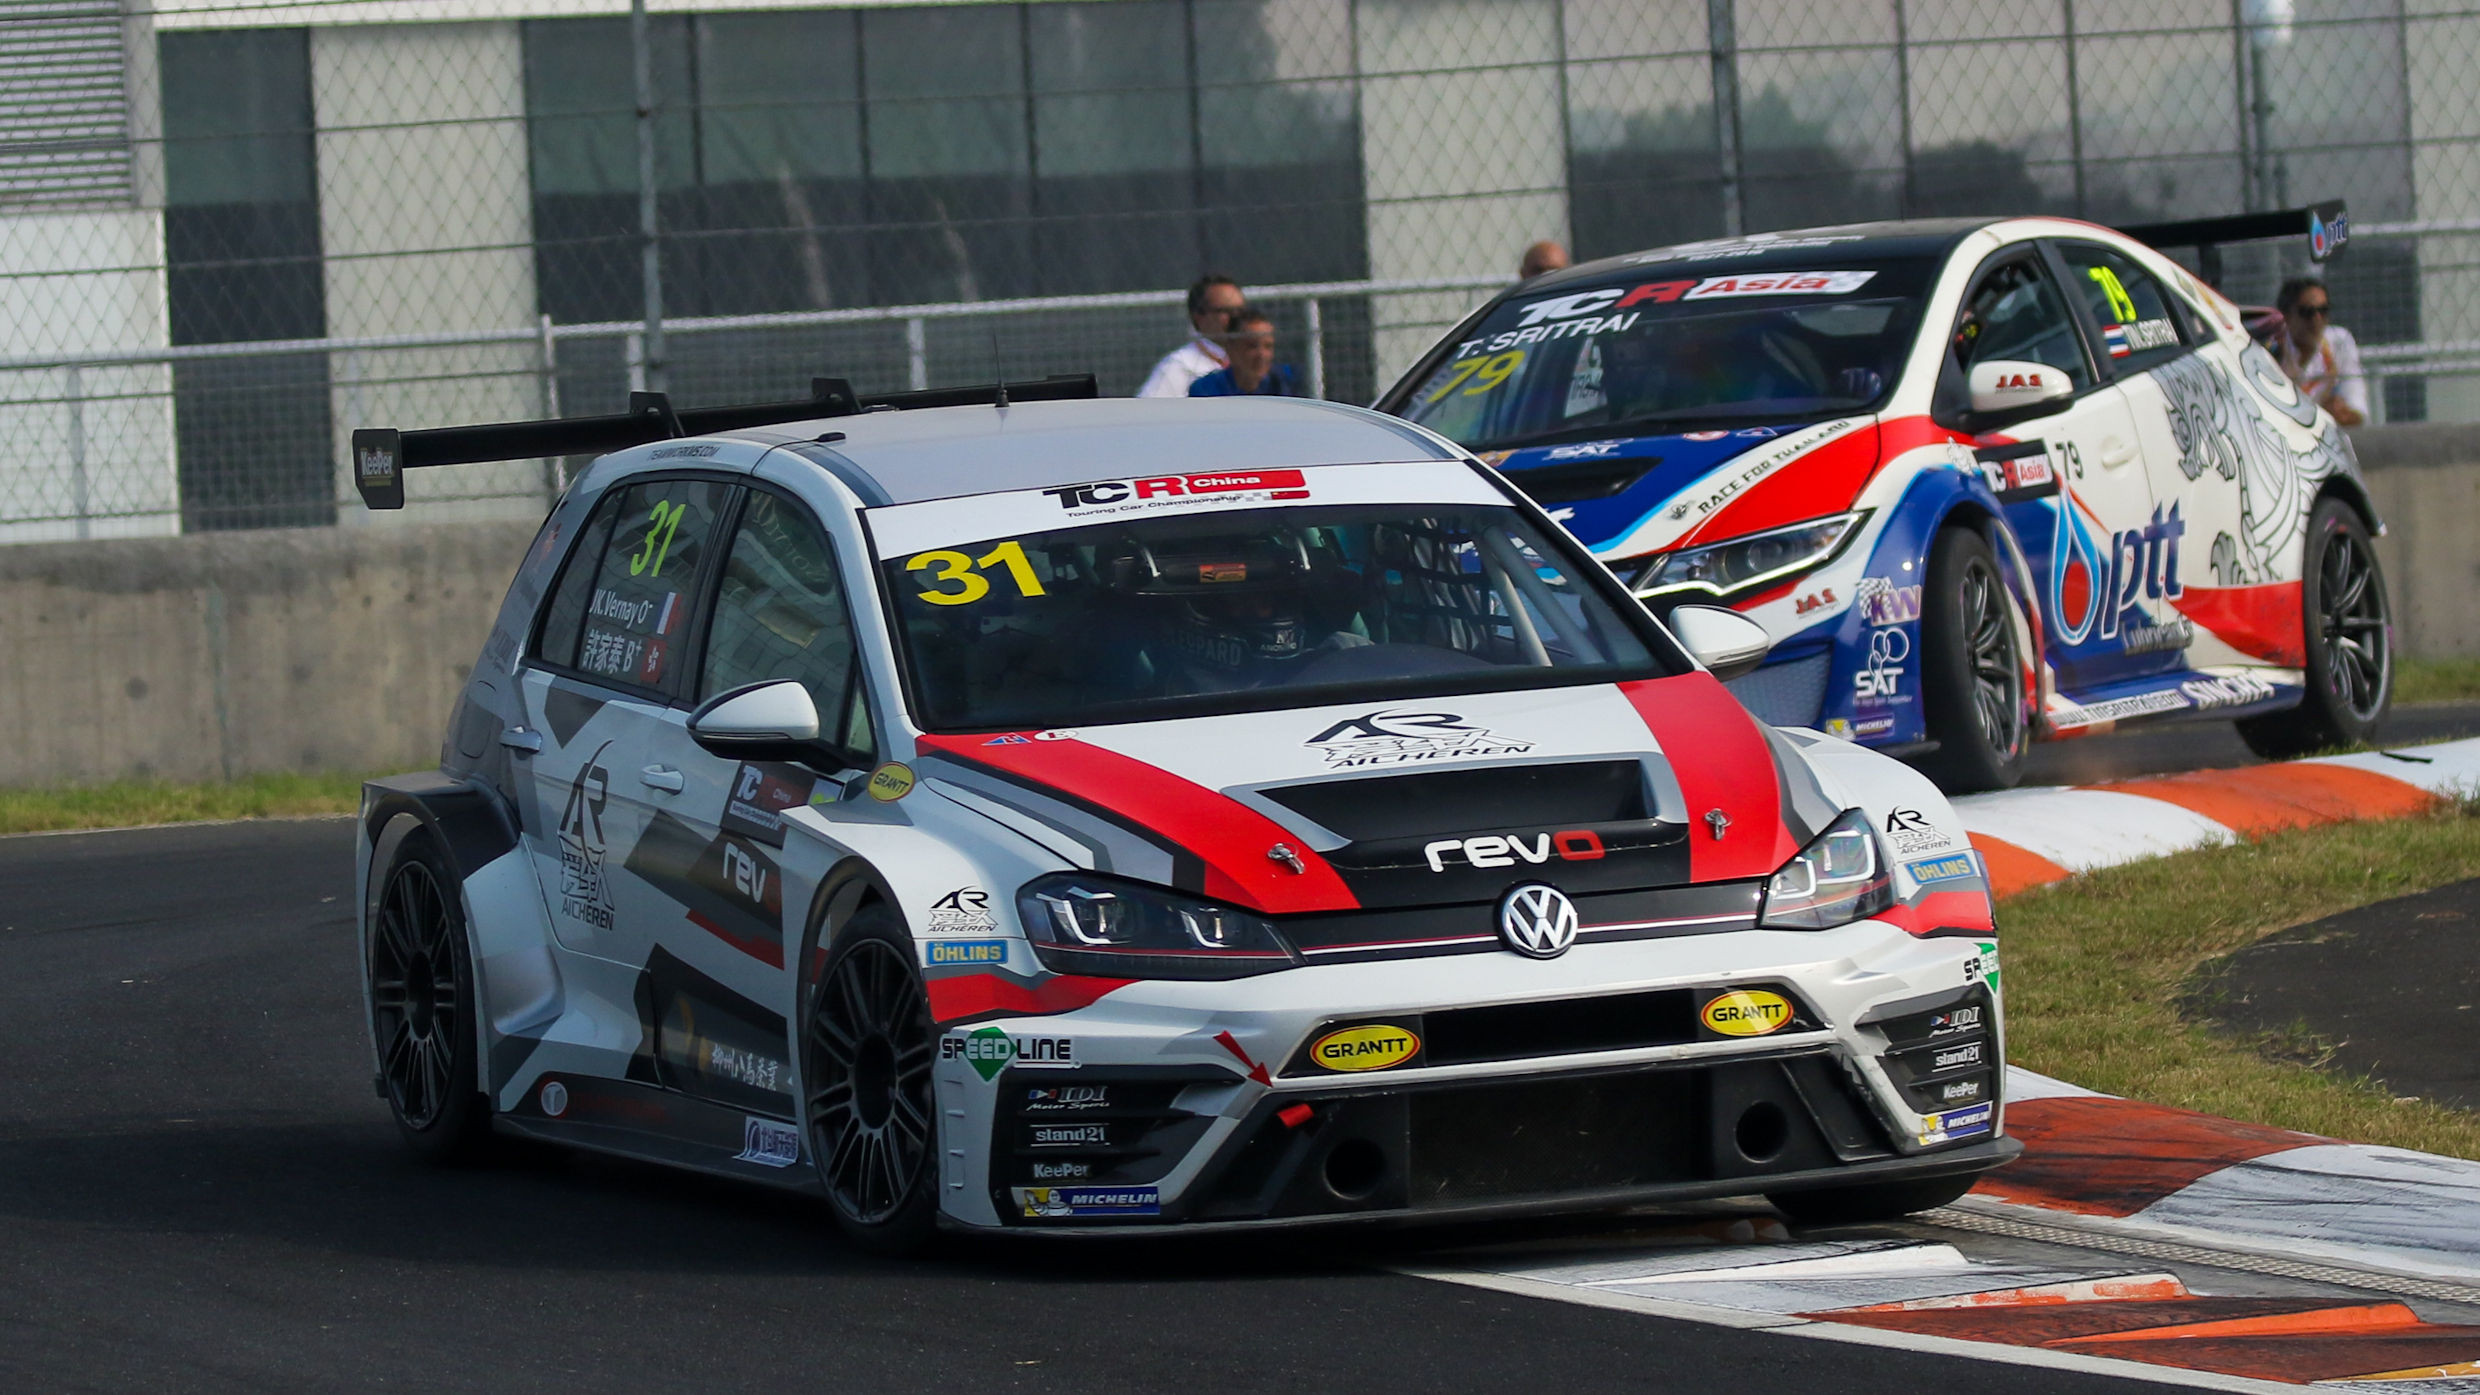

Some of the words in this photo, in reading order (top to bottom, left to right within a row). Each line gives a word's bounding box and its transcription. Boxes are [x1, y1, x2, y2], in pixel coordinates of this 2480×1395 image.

[1517, 279, 1698, 327] TCR
[1696, 273, 1830, 296] Asia
[2088, 266, 2137, 323] 79
[1488, 311, 1641, 353] SRITRAI
[1426, 350, 1526, 403] 79
[1995, 374, 2043, 389] JAS
[1697, 479, 1743, 514] RACE
[1741, 460, 1772, 483] FOR
[1773, 420, 1851, 462] THAILAND
[2020, 461, 2045, 481] Asia
[2055, 440, 2084, 480] 79
[1042, 476, 1186, 509] TCR
[1193, 476, 1262, 488] China
[1067, 507, 1116, 518] Touring
[1120, 504, 1144, 512] Car
[1148, 495, 1243, 508] Championship
[630, 499, 686, 578] 31
[905, 541, 1046, 606] 31
[2101, 496, 2186, 639] ptt
[1796, 588, 1838, 615] JAS
[1855, 667, 1904, 697] SAT
[1855, 719, 1894, 732] MICHELIN
[1330, 745, 1532, 770] AICHEREN
[874, 772, 909, 793] GRANTT
[1424, 830, 1605, 873] revo
[1901, 840, 1952, 854] AICHEREN
[1911, 859, 1971, 881] ÖHLINS
[561, 897, 615, 931] AICHEREN
[928, 925, 996, 933] AICHEREN
[933, 943, 1003, 962] ÖHLINS
[1712, 1003, 1782, 1022] GRANTT
[1929, 1027, 1954, 1038] Motor
[1956, 1023, 1982, 1033] Sports
[1323, 1038, 1407, 1060] GRANTT
[1935, 1047, 1980, 1066] stand21
[1943, 1081, 1979, 1099] KeePer
[1026, 1102, 1065, 1111] Motor
[1068, 1101, 1110, 1110] Sports
[1947, 1112, 1991, 1129] MICHELIN
[1036, 1127, 1105, 1141] stand21
[1033, 1163, 1090, 1178] KeePer
[1071, 1194, 1158, 1204] MICHELIN
